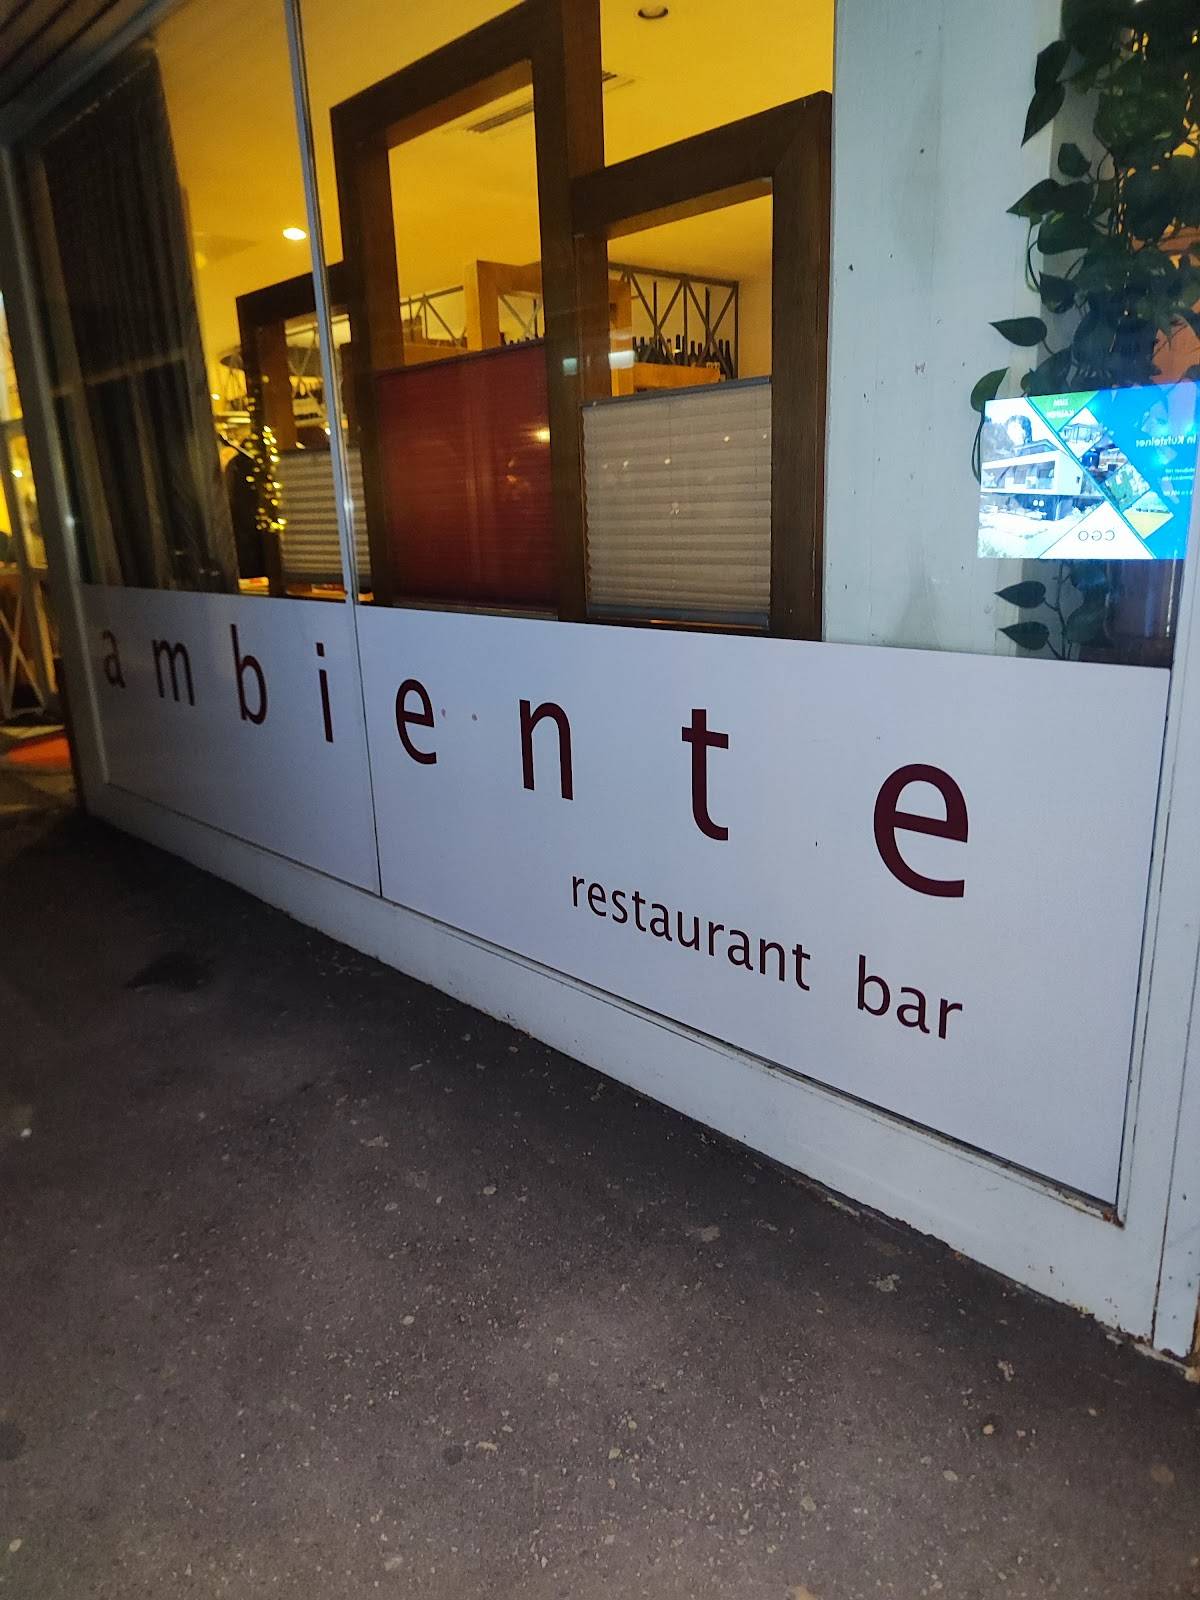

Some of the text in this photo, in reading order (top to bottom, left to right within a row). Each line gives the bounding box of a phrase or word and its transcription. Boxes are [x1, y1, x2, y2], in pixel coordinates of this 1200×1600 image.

[102, 624, 969, 898] ambiente
[572, 875, 963, 1040] restaurant bar
